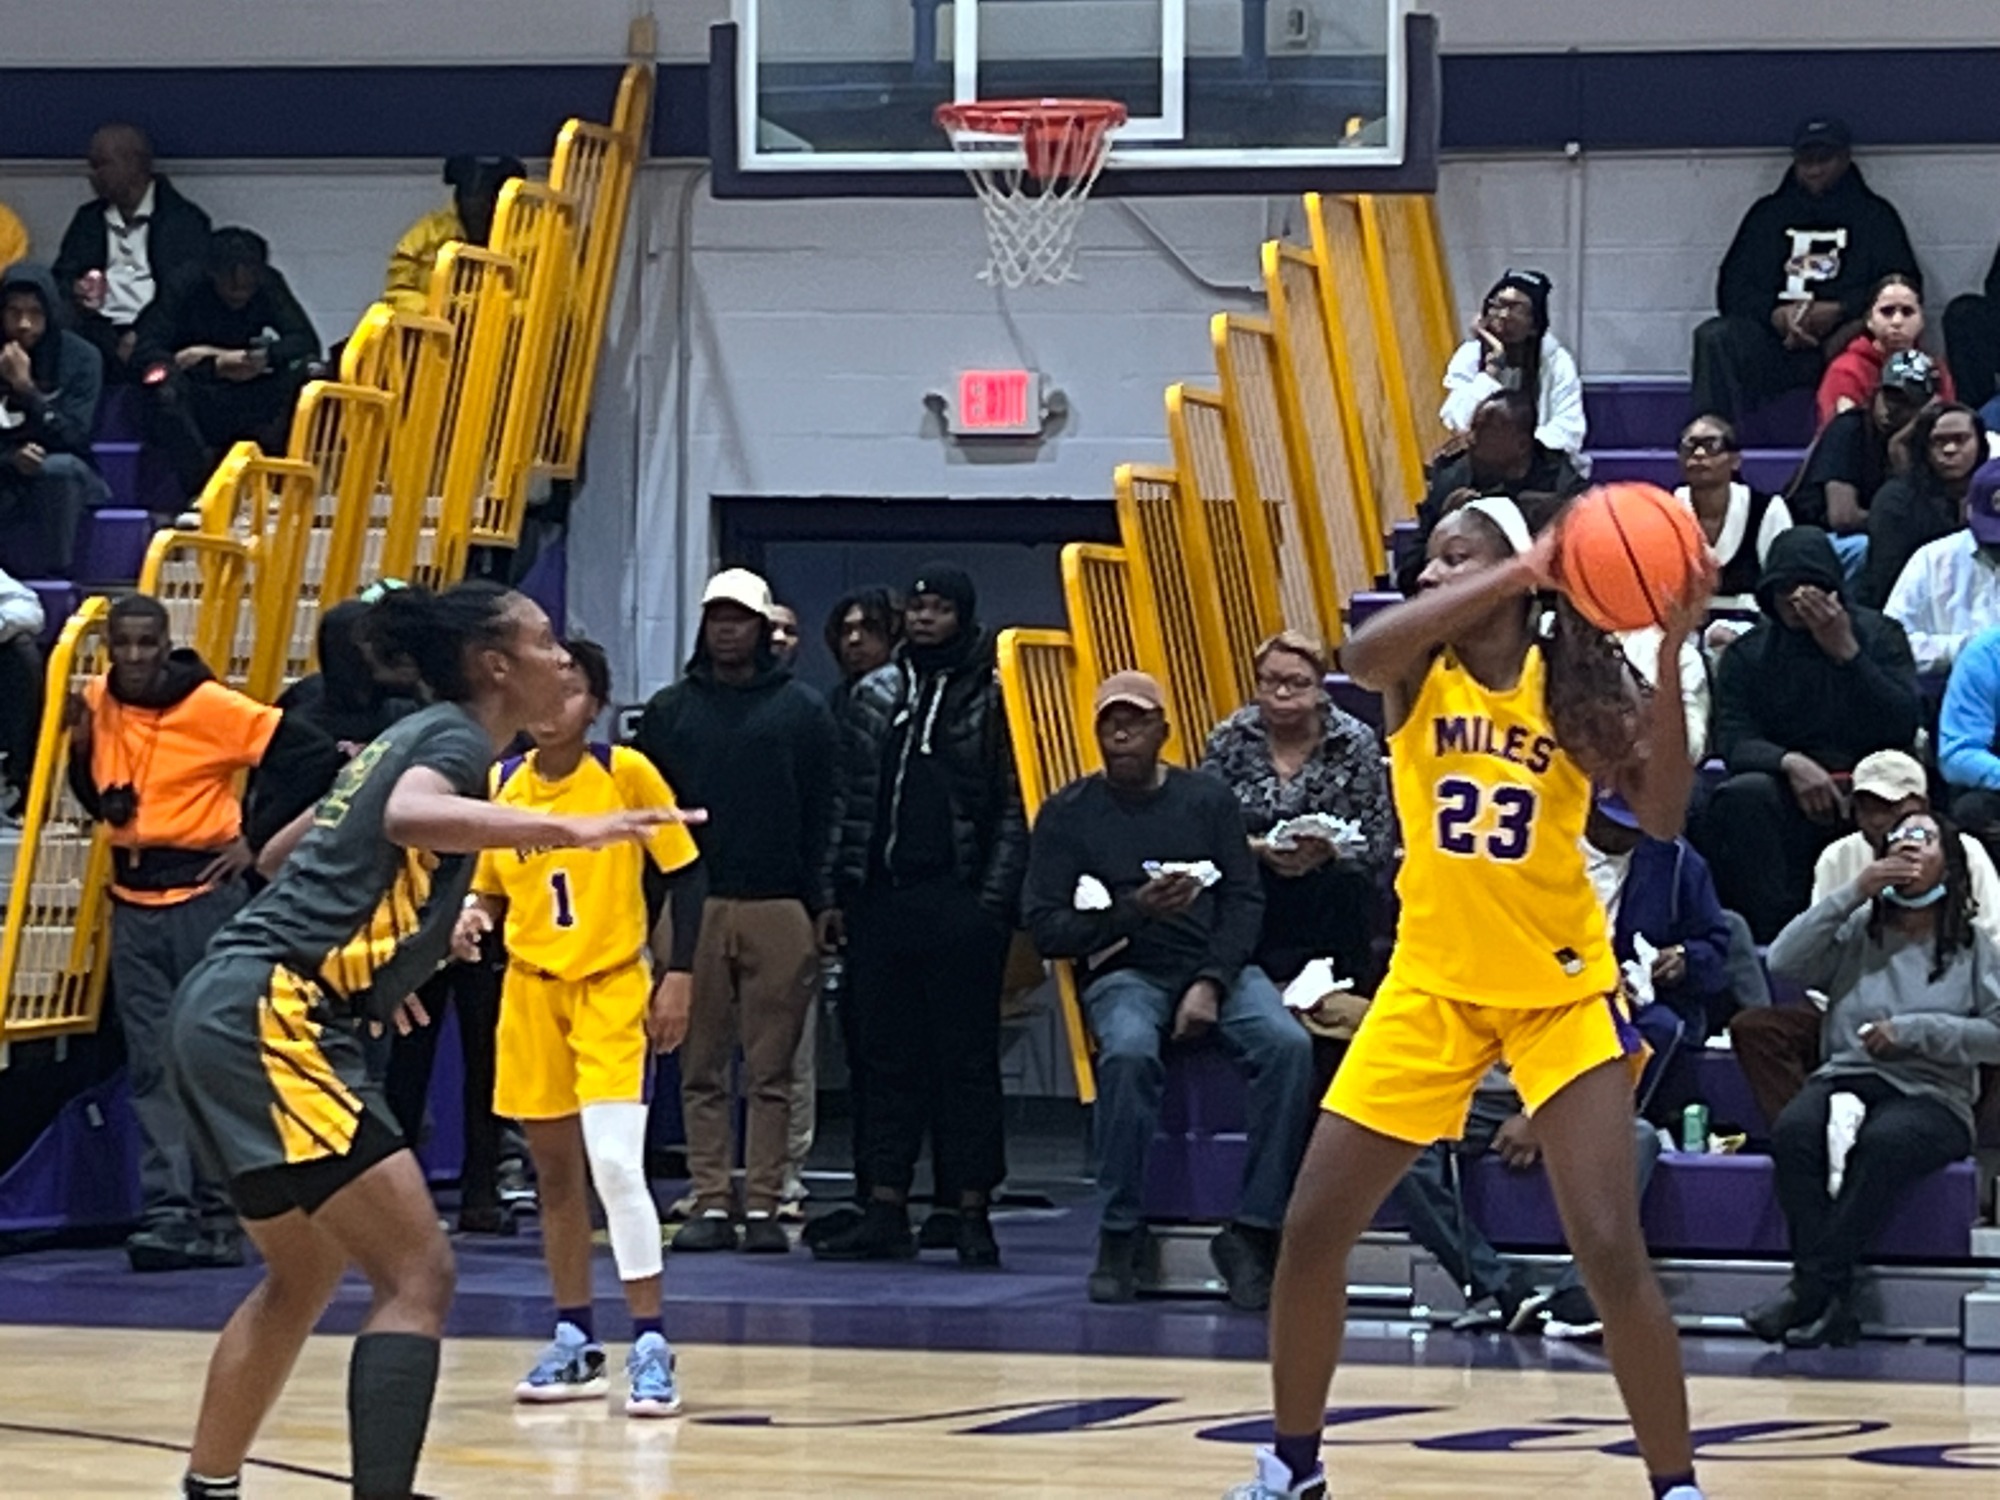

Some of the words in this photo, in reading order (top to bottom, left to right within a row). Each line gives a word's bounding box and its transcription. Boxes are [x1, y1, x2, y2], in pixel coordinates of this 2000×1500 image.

[1434, 716, 1556, 773] MILES
[1437, 779, 1536, 859] 23
[551, 872, 573, 927] 1
